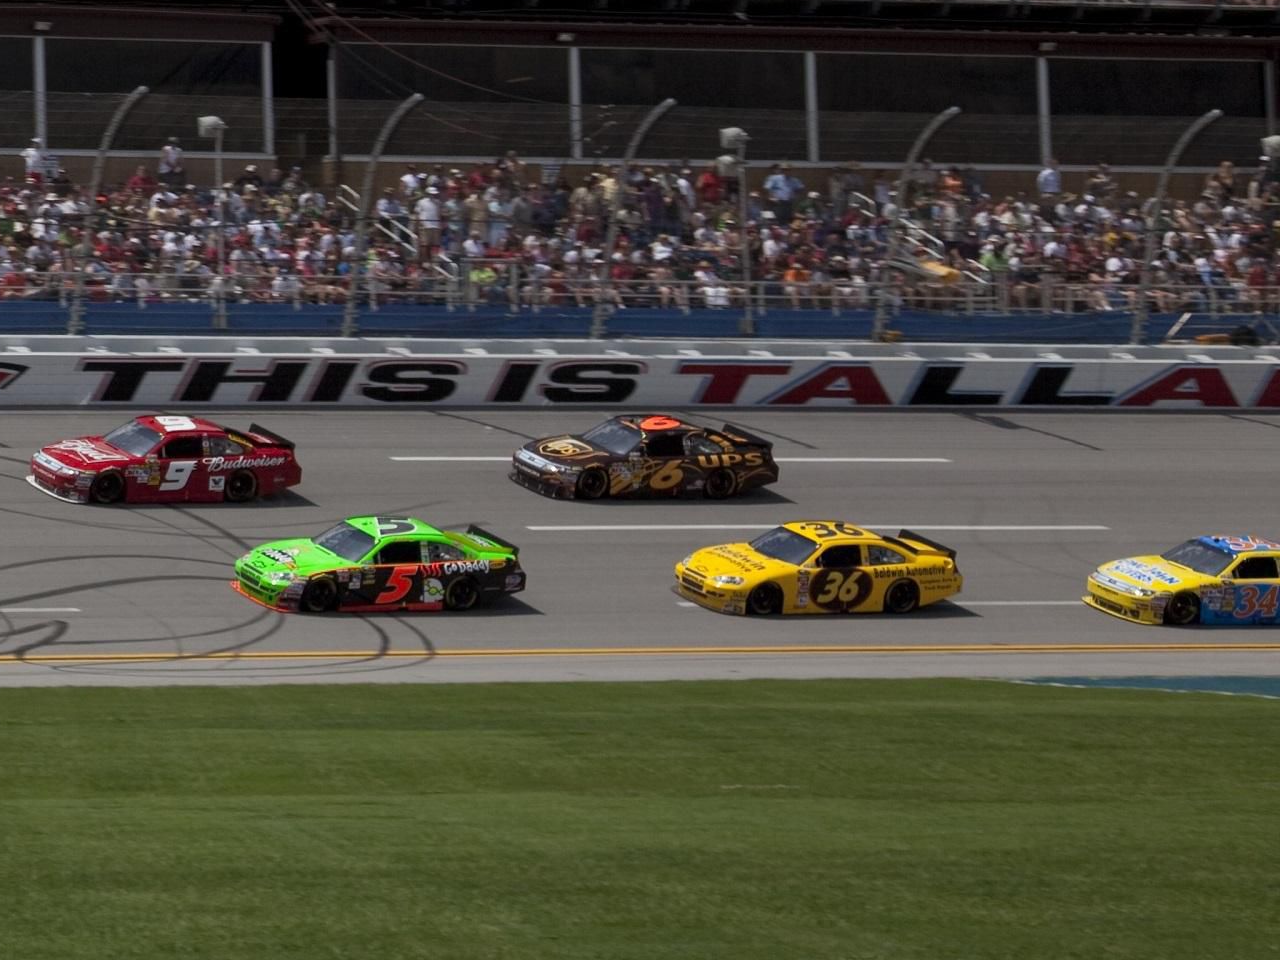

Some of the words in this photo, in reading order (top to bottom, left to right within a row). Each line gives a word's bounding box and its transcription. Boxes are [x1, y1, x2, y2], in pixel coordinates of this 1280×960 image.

[80, 357, 467, 403] THIS
[488, 357, 648, 403] IS
[674, 358, 1280, 408] TALLA
[155, 416, 197, 432] 9
[640, 416, 681, 431] 6
[159, 460, 198, 491] 9
[202, 456, 285, 472] Budweiser
[649, 460, 683, 489] 6
[375, 565, 419, 603] 5
[873, 567, 904, 578] Baldwin
[906, 565, 945, 577] Automotive
[816, 571, 862, 603] 36
[1233, 585, 1280, 619] 34
